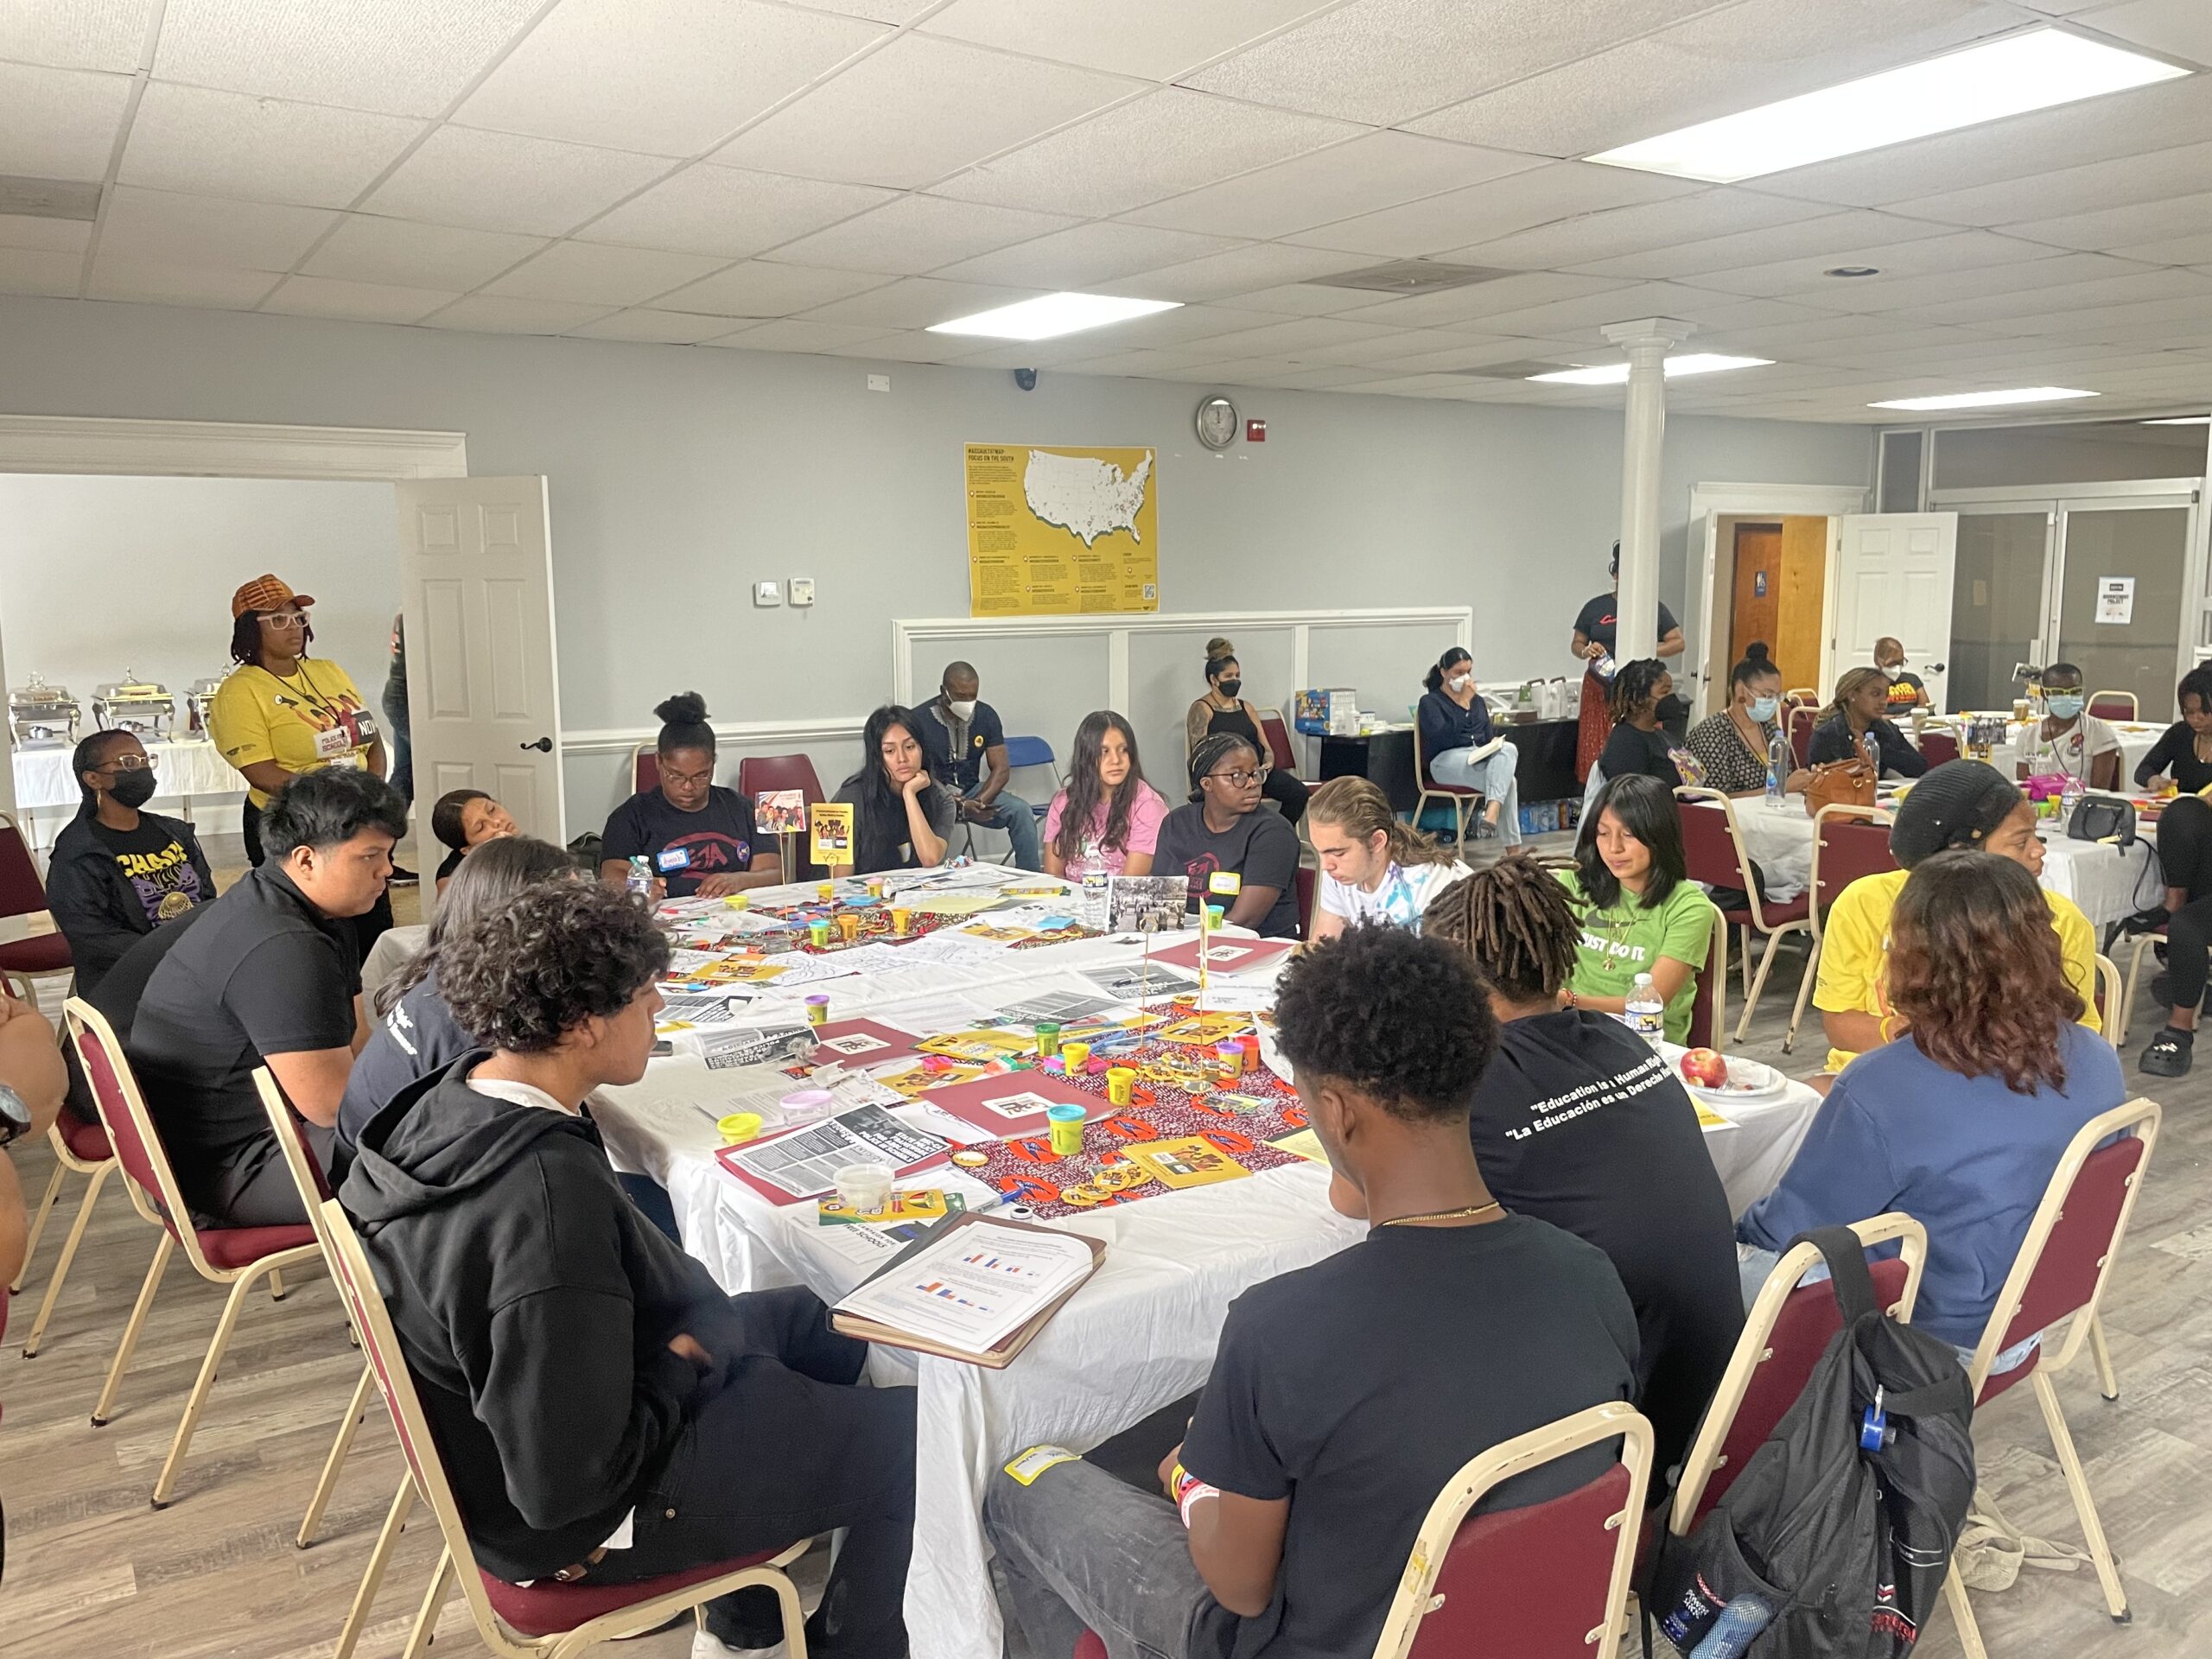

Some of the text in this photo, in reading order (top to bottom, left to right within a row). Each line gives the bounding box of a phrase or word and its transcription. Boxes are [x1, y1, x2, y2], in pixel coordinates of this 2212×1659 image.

[1608, 941, 1630, 958] DO
[1530, 1084, 1599, 1114] "Education
[1505, 1126, 1532, 1141] "La
[1533, 1099, 1601, 1132] Educación
[1600, 1094, 1616, 1105] es
[858, 1130, 881, 1145] POLICE
[856, 1230, 886, 1248] SCHOOLS
